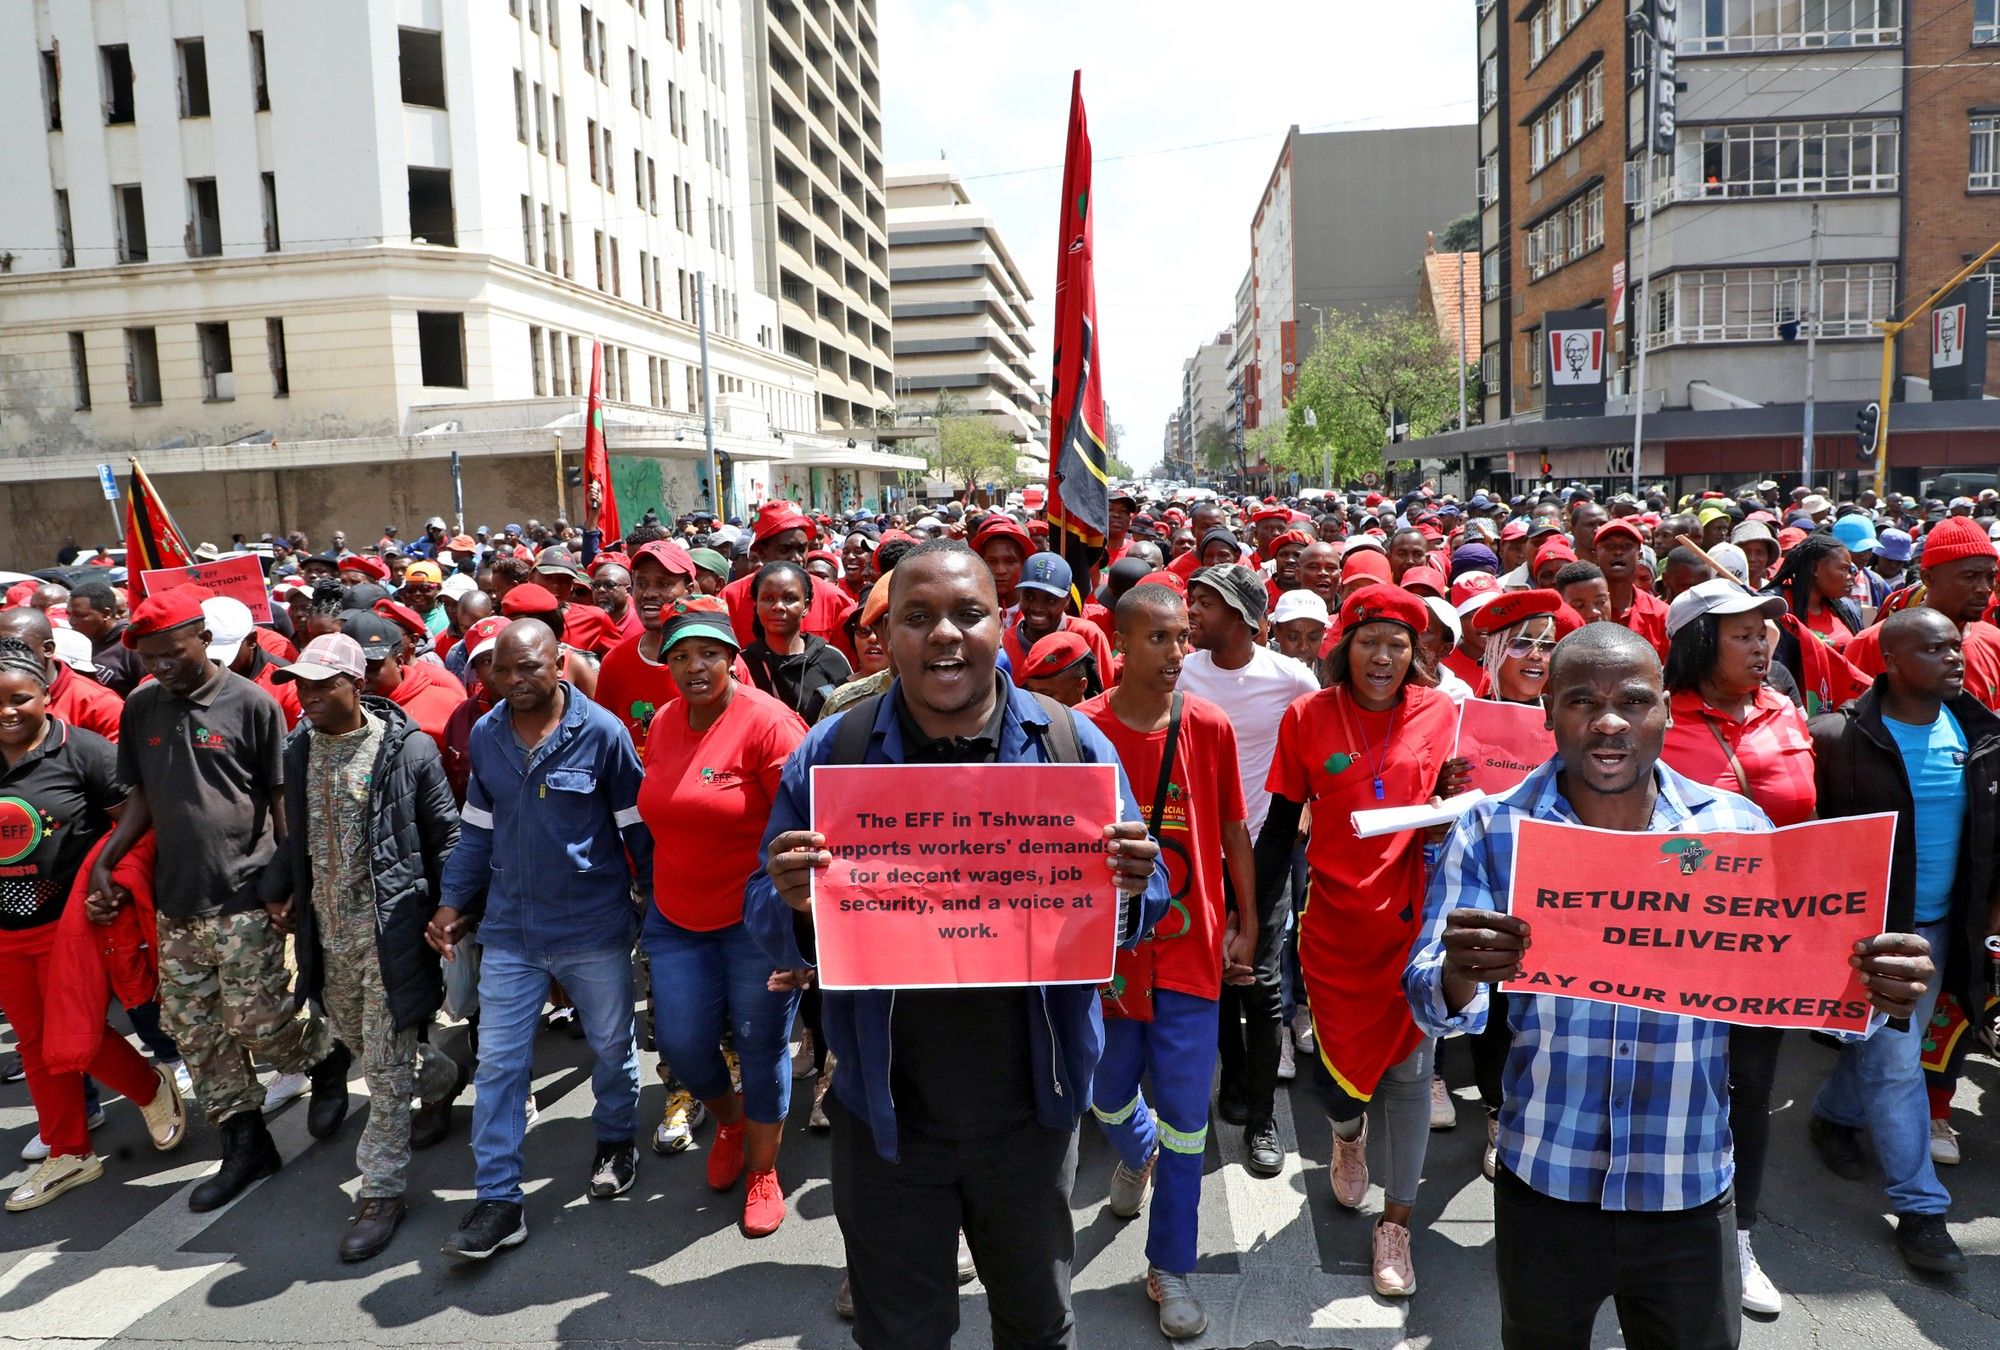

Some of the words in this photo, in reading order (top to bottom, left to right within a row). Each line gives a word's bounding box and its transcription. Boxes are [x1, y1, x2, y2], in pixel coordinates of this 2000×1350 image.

[1605, 446, 1633, 474] KFC
[204, 570, 218, 578] EFF
[713, 773, 733, 781] EFF
[857, 813, 897, 828] The
[905, 812, 945, 827] EFF
[953, 812, 971, 826] in
[979, 811, 1075, 827] Tshwane
[2, 824, 28, 838] EFF
[919, 839, 1011, 854] workers'
[1714, 856, 1762, 874] EFF
[850, 868, 879, 883] for
[887, 867, 960, 883] decent
[968, 869, 1043, 886] wages,
[1050, 866, 1083, 885] job
[840, 895, 934, 914] security,
[942, 895, 980, 910] and
[989, 898, 1001, 910] a
[1008, 894, 1065, 909] voice
[1072, 894, 1093, 908] at
[1536, 889, 1689, 912] RETURN
[1704, 891, 1867, 918] SERVICE
[938, 923, 998, 938] work.
[1603, 926, 1791, 953] DELIVERY
[1507, 971, 1577, 988] PAY
[1588, 980, 1666, 1002] OUR
[1679, 992, 1867, 1019] WORKERS
